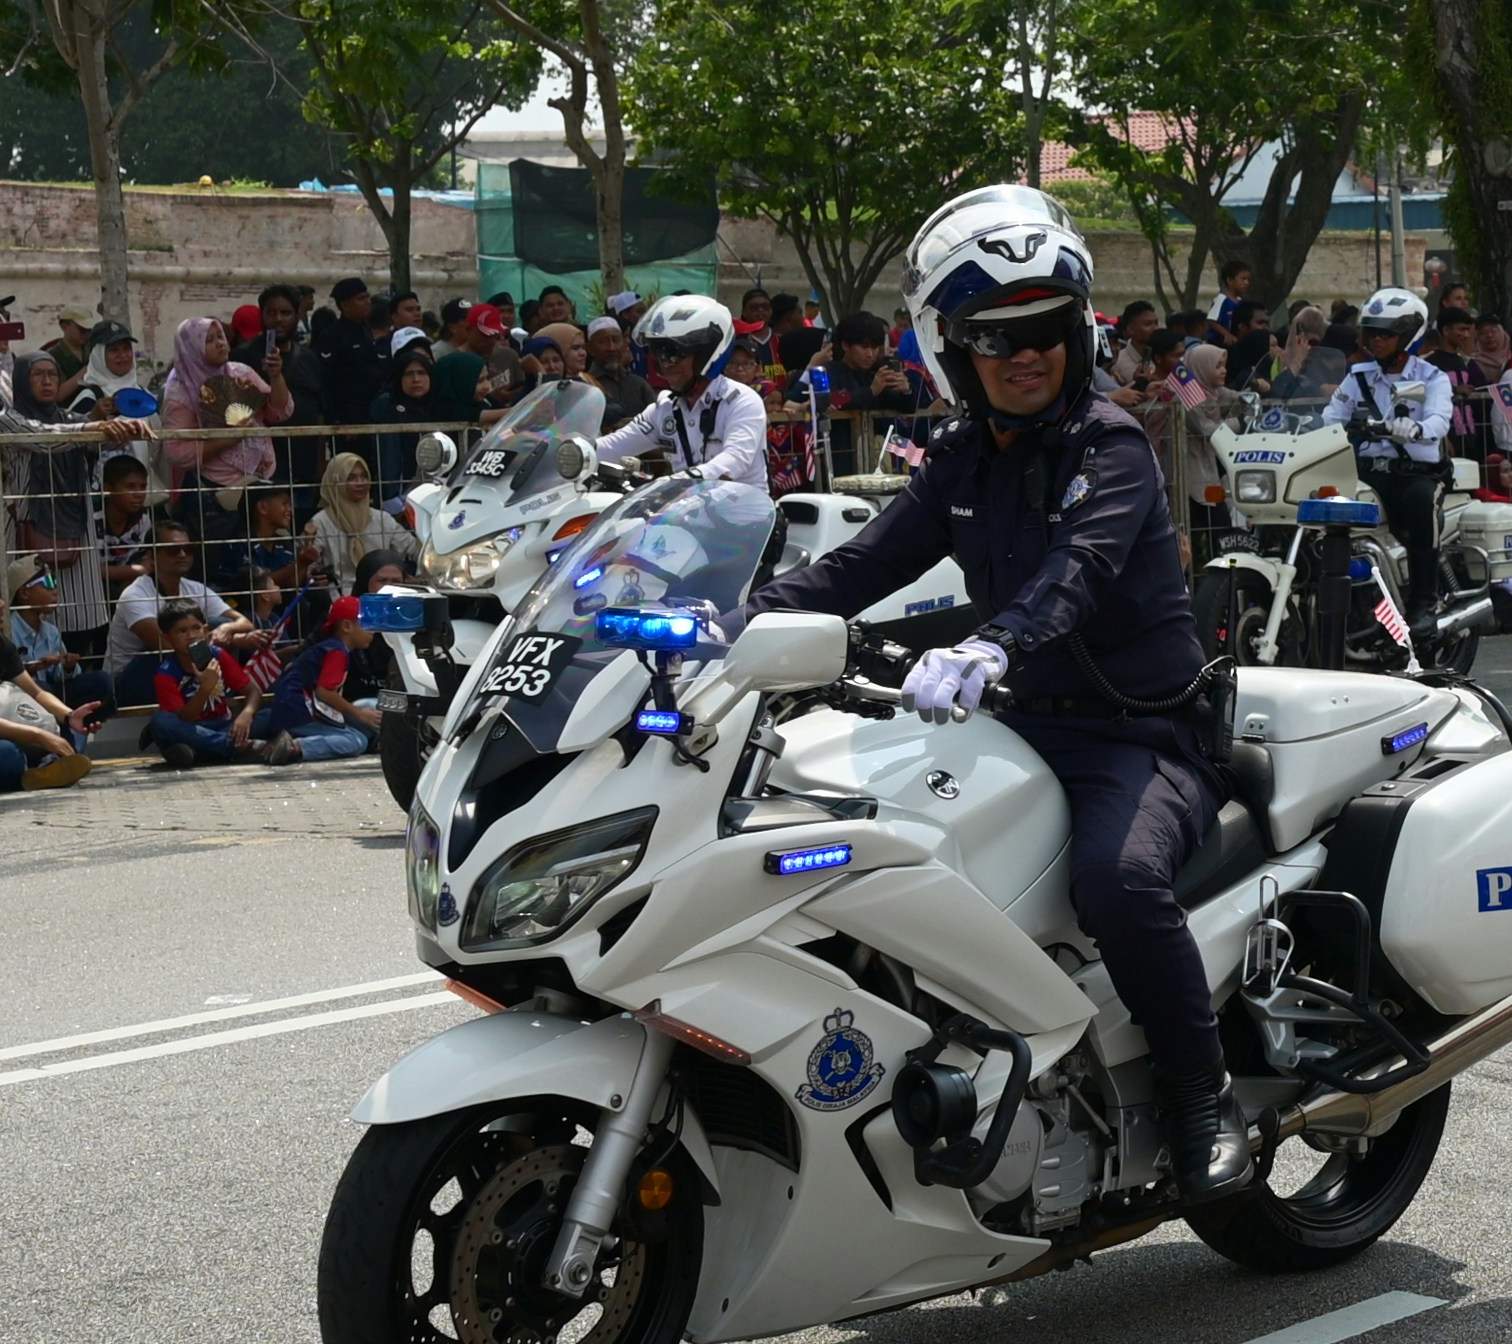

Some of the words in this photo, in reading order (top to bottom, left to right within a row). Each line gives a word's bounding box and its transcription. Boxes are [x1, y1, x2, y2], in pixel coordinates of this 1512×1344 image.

[481, 451, 505, 463] WB
[1236, 451, 1284, 464] POLIS
[519, 492, 562, 515] POLIS
[507, 637, 565, 666] VFX
[480, 664, 551, 696] 8253
